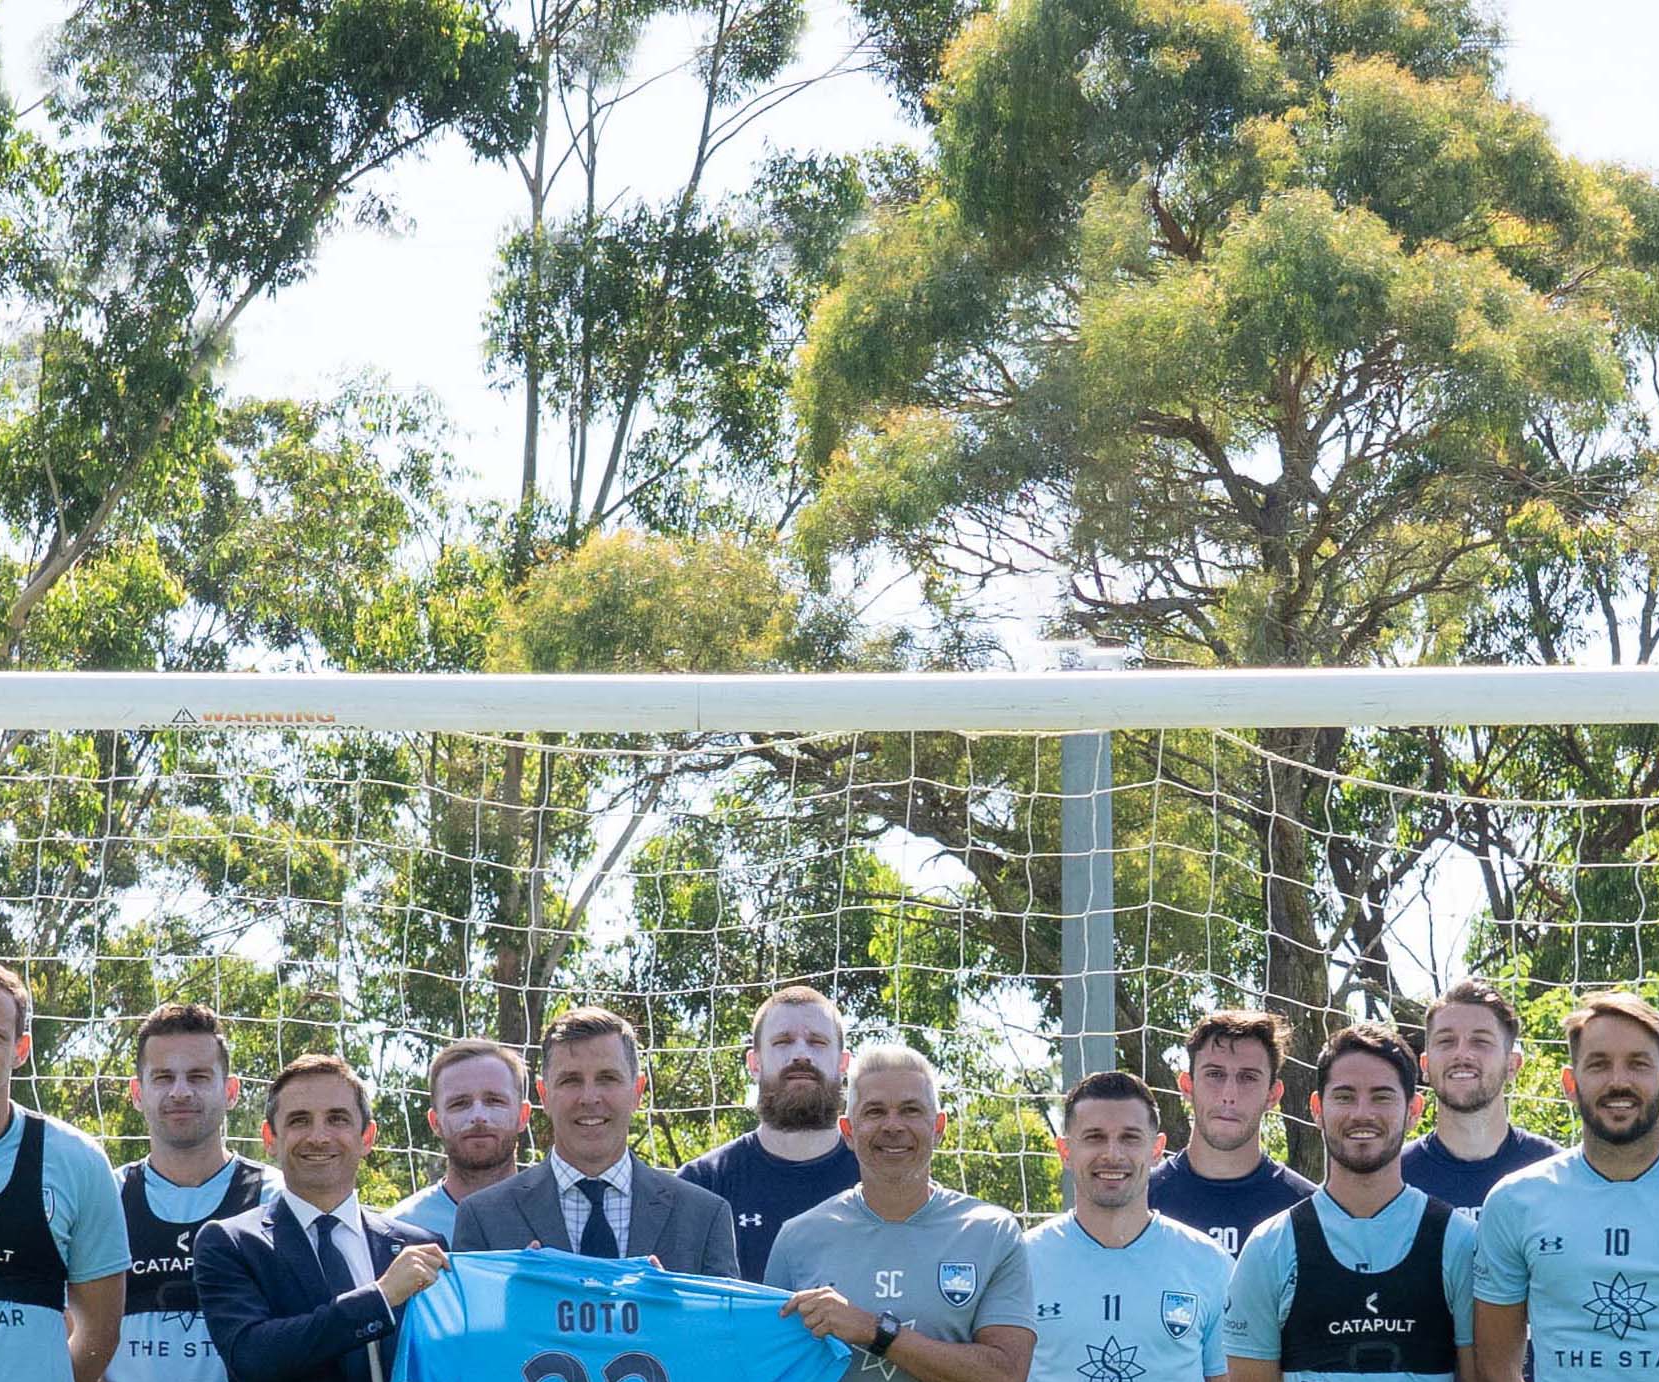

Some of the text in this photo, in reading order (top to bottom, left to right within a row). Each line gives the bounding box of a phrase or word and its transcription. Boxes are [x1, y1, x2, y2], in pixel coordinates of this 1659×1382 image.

[202, 711, 336, 723] WARNING
[1604, 1227, 1630, 1256] 10
[132, 1256, 196, 1275] CATAP
[874, 1269, 903, 1299] SC
[557, 1299, 640, 1335] GOTO
[1102, 1294, 1122, 1322] 11
[1329, 1319, 1416, 1336] CATAPULT
[129, 1340, 216, 1358] THE ST
[1555, 1350, 1603, 1369] THE
